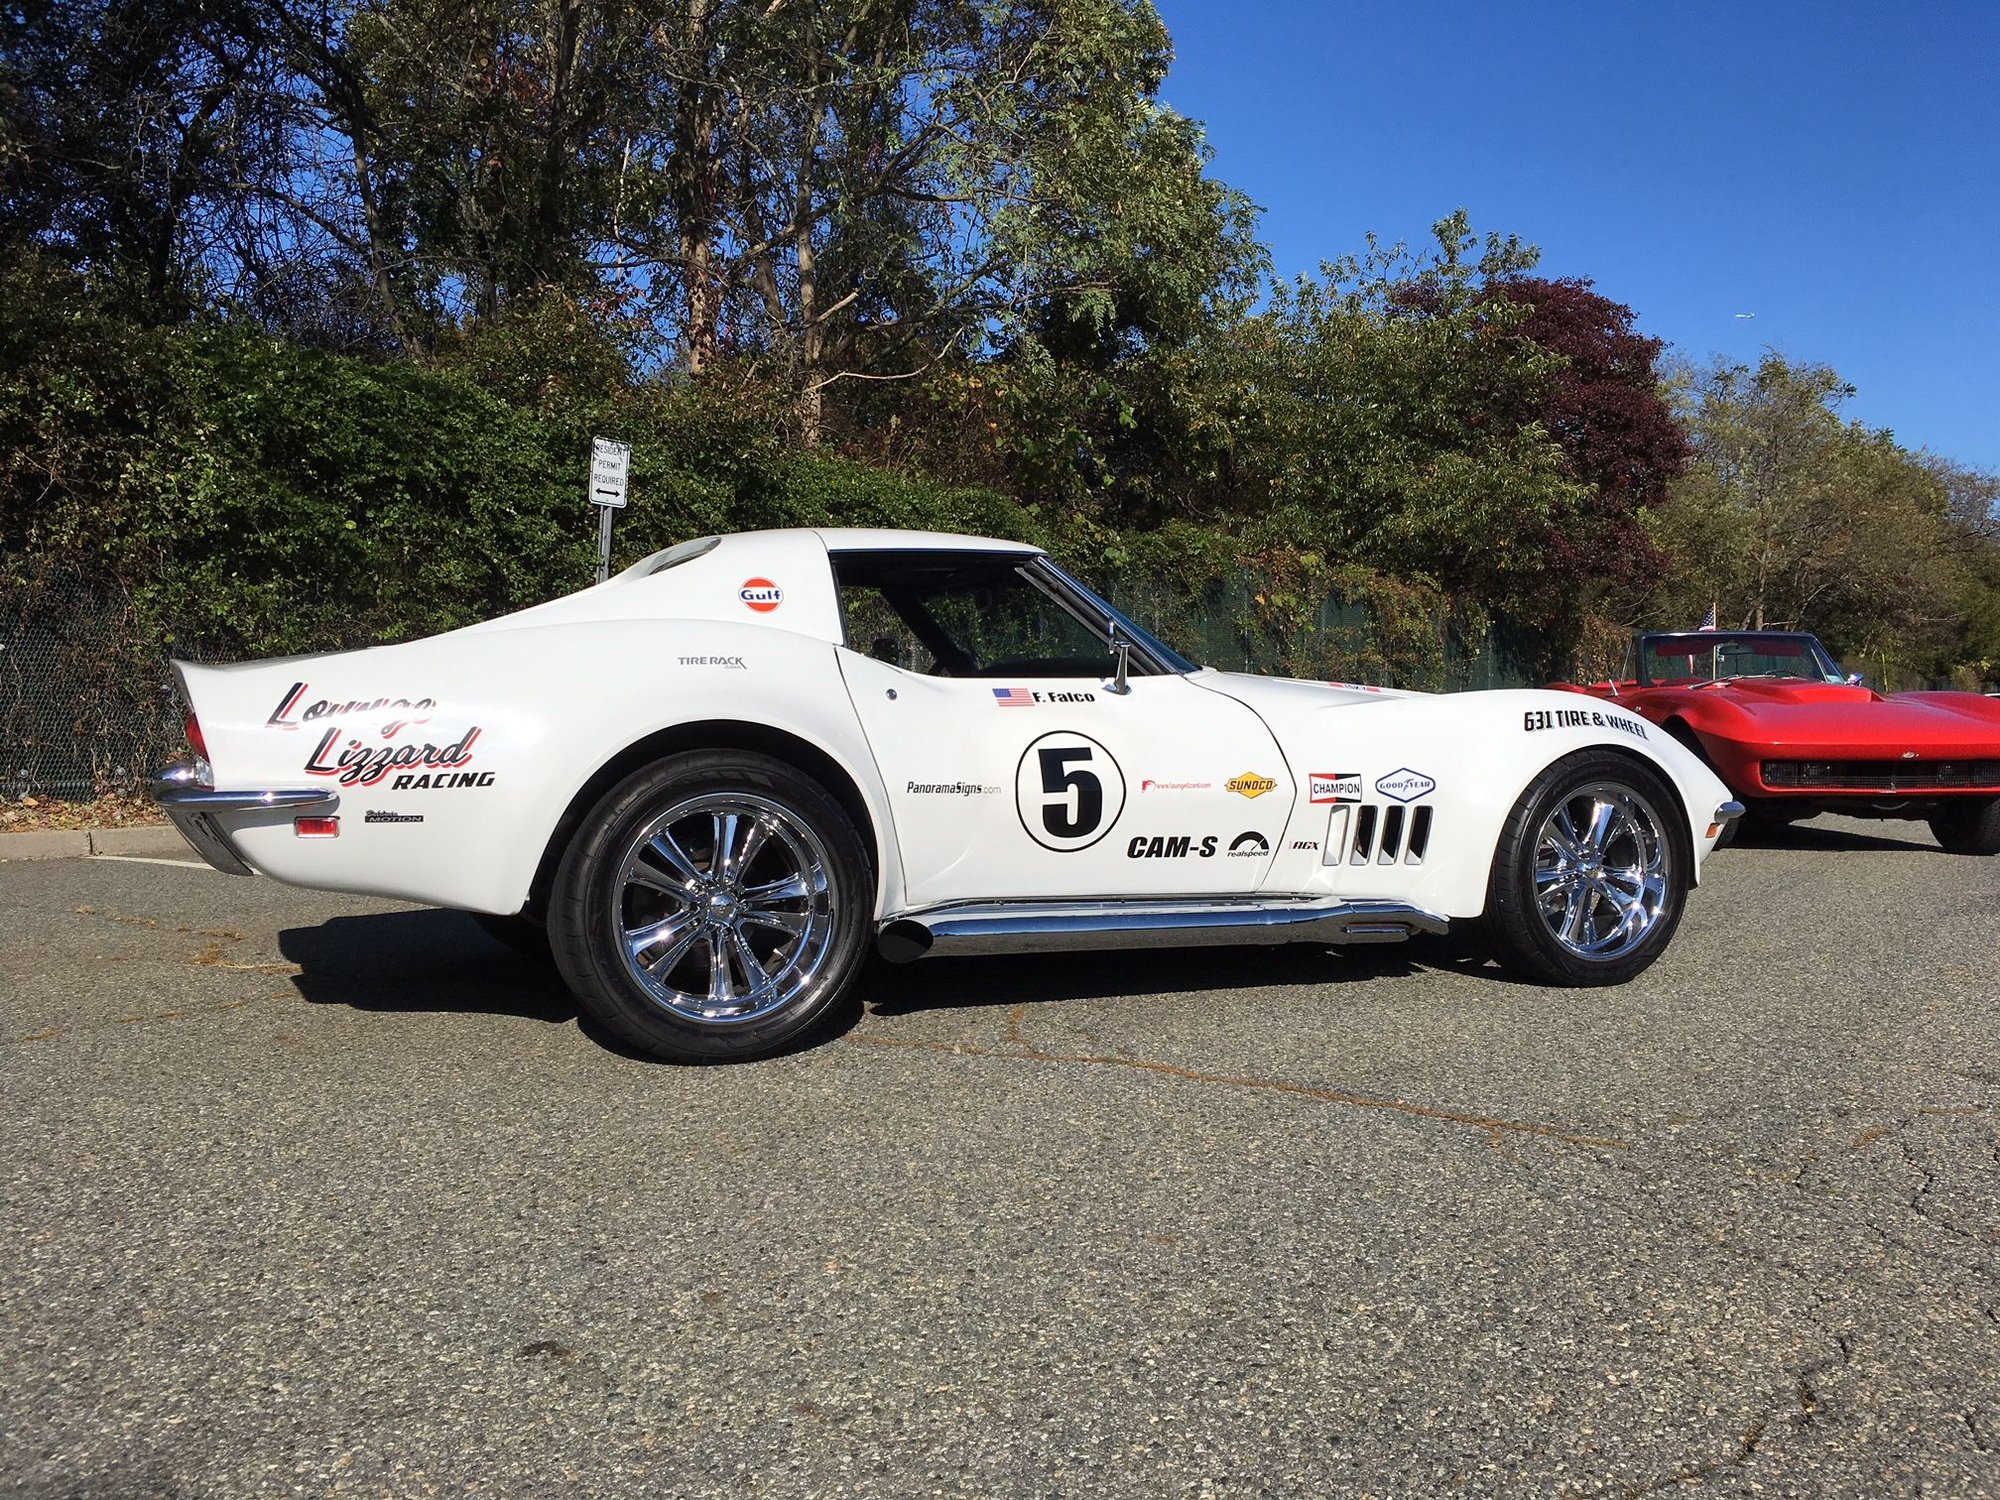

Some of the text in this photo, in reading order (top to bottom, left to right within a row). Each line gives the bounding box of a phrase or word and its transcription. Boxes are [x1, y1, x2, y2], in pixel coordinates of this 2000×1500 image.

[598, 460, 621, 471] PERMIT
[594, 473, 625, 487] REQUIRED
[740, 589, 781, 600] Gulf
[1032, 692, 1096, 703] F. Falco
[1524, 710, 1650, 742] 631 TIRE & WHEEL
[303, 726, 482, 788] Lizzard
[391, 771, 496, 791] RACING
[1229, 780, 1273, 790] SUNOCO
[1313, 783, 1360, 793] CHAMPION
[906, 781, 1002, 797] PanoramaSigns.com
[1037, 747, 1103, 838] 5
[1127, 836, 1218, 859] CAM-S
[1227, 850, 1270, 858] realspeed
